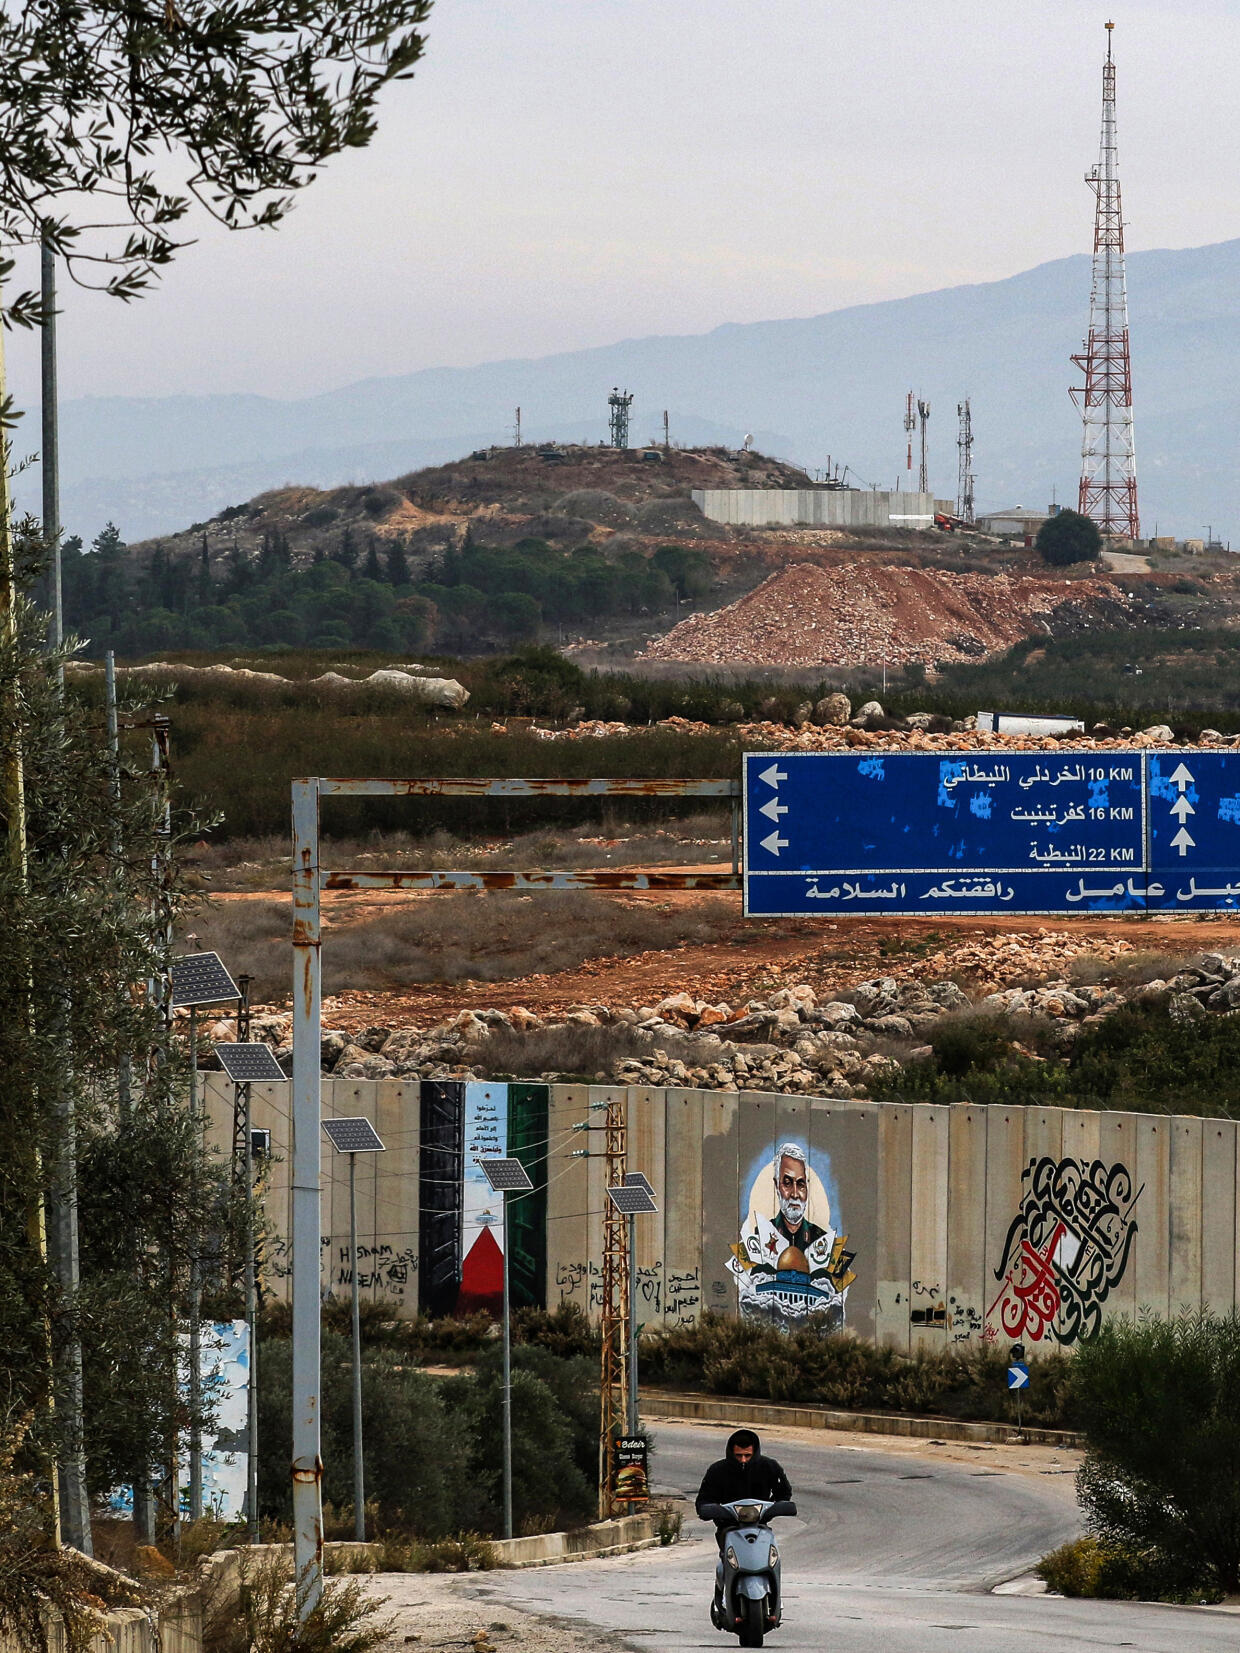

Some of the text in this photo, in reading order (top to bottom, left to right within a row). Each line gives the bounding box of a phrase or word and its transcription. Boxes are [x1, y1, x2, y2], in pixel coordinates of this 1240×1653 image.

[943, 764, 1133, 791] 10 KM الخردلي الليطاني
[1089, 808, 1105, 820] 16
[1110, 808, 1134, 820] KM
[1029, 841, 1134, 867] 22 KM النبطية
[805, 877, 906, 900] السلامة
[918, 877, 1014, 900] رافقتكم
[1065, 877, 1166, 902] عامل
